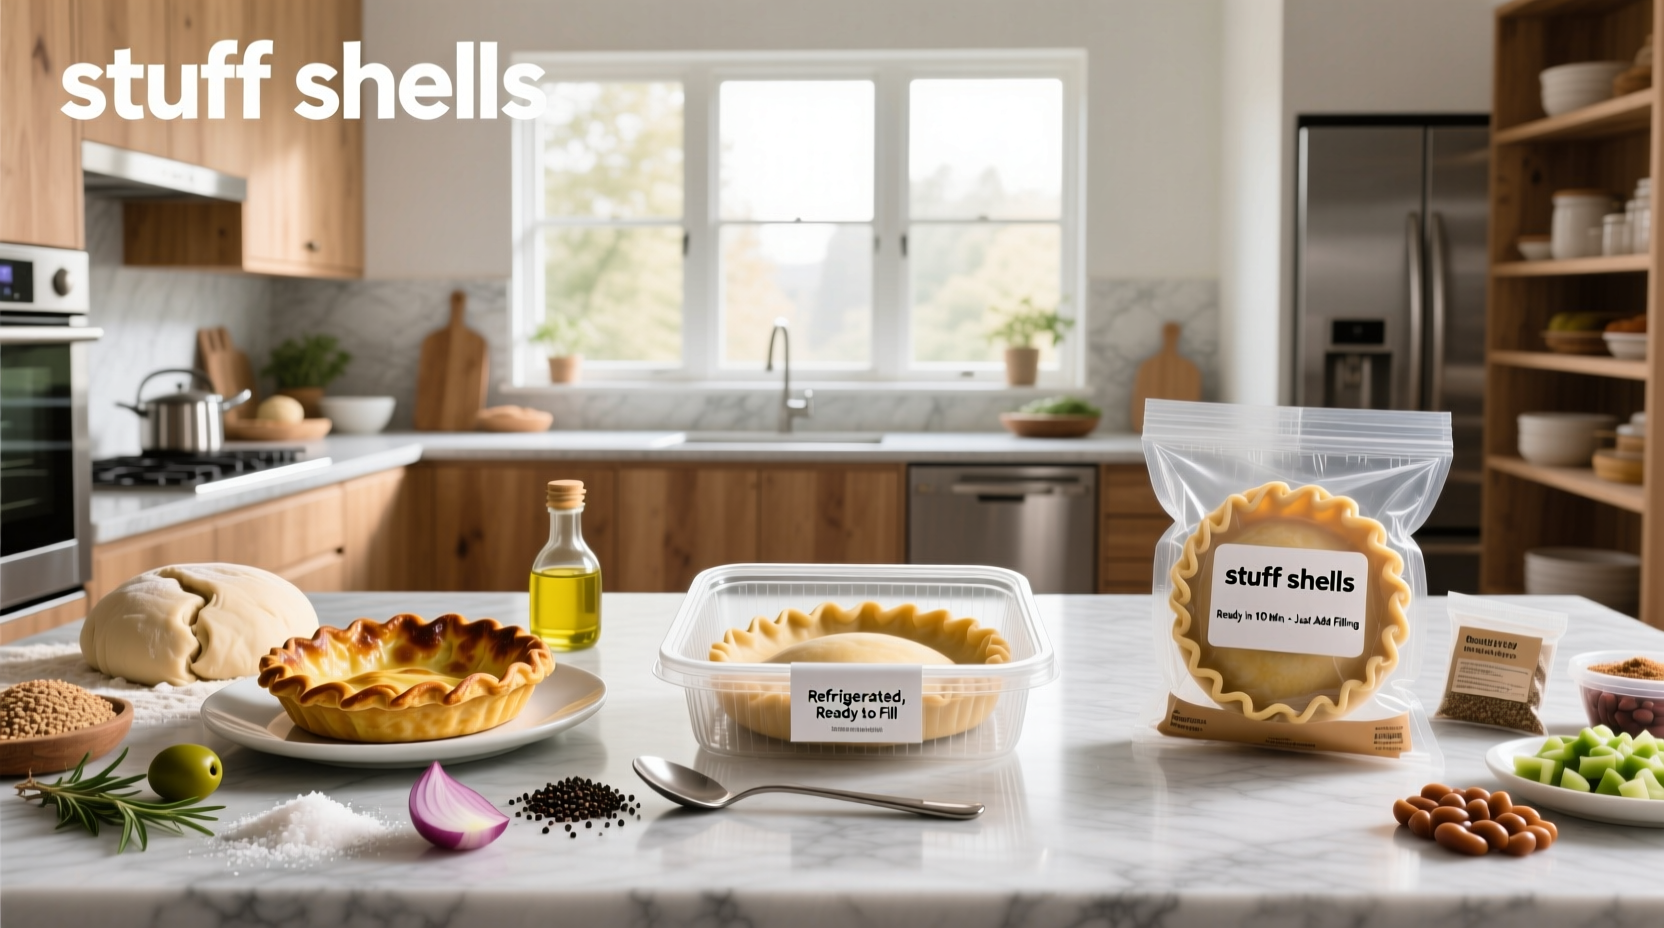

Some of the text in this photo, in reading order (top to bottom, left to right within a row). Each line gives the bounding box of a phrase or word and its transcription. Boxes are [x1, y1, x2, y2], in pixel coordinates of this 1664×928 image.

[1225, 566, 1355, 593] stuff shells
[1256, 612, 1268, 622] 10
[808, 689, 905, 706] Refrigerated,
[816, 706, 898, 722] Ready to Fill
